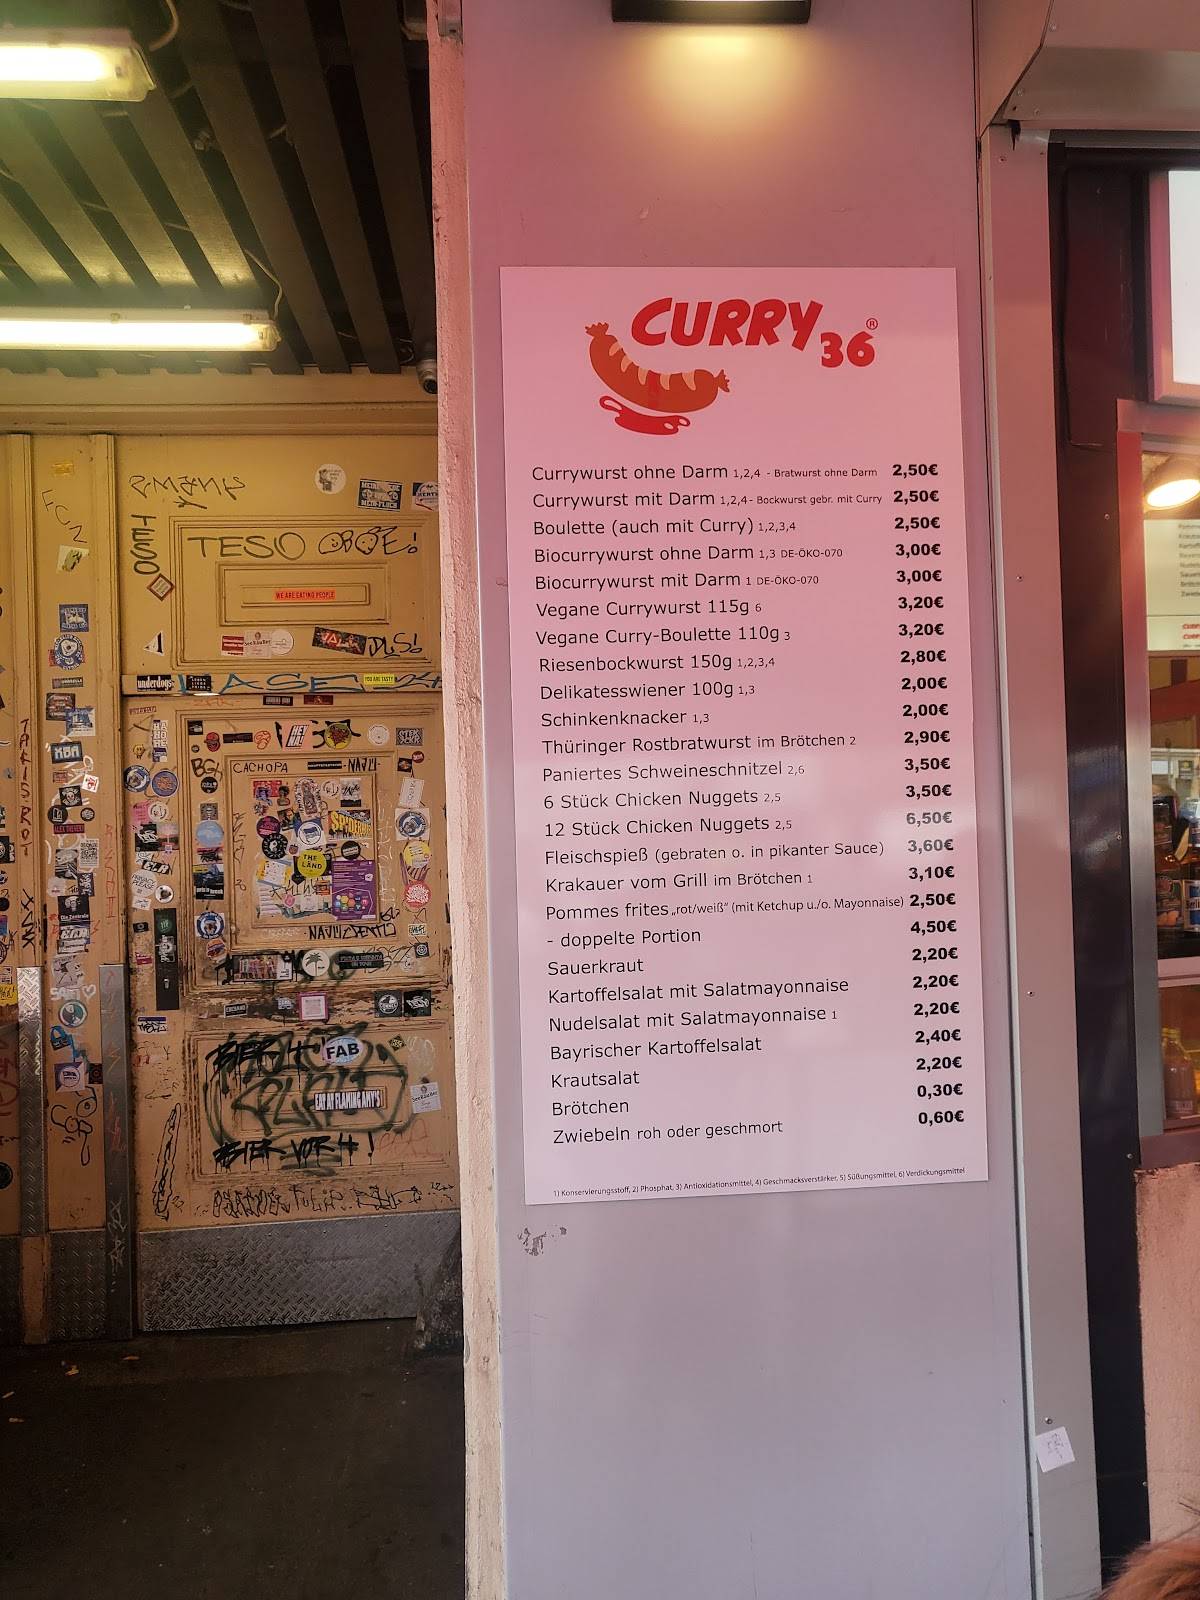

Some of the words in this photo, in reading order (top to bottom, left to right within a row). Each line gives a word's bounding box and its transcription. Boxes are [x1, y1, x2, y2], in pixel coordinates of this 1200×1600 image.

[631, 297, 823, 352] CURRY
[820, 330, 876, 368] 36
[532, 466, 628, 484] Currywurst
[633, 464, 676, 480] ohne
[682, 465, 728, 479] Darm
[733, 468, 761, 480] 1,2,4
[774, 468, 822, 478] Bratwurst
[824, 468, 848, 477] ohne
[851, 468, 878, 477] Darm
[892, 464, 938, 479] 2,50€
[533, 493, 629, 511] Currywurst
[635, 492, 663, 506] mit
[669, 492, 715, 506] Darm
[756, 495, 807, 505] Bockwurst
[809, 495, 833, 506] gebr.
[837, 494, 853, 504] mit
[855, 494, 883, 505] Curry
[894, 490, 940, 506] 2,50€
[533, 520, 605, 535] Boulette
[612, 519, 659, 538] (auch
[666, 519, 694, 533] mit
[700, 517, 754, 535] Curry)
[758, 521, 796, 534] 1,2,3,4
[894, 516, 940, 532] 2,50€
[187, 532, 306, 560] TESO
[534, 547, 654, 565] Biocurrywurst
[659, 546, 701, 561] ohne
[708, 545, 754, 560] Darm
[759, 549, 776, 561] 1,3
[780, 548, 843, 559] DE-ÖKO-070
[896, 544, 941, 559] 3,00€
[535, 574, 655, 592] Biocurrywurst
[661, 573, 689, 588] mit
[695, 573, 741, 587] Darm
[756, 575, 819, 586] DE-ÖKO-070
[896, 570, 942, 585] 3,00€
[275, 591, 284, 600] WE
[285, 591, 295, 599] ARE
[296, 591, 315, 599] EATING
[316, 591, 335, 599] PEOPLE
[535, 603, 600, 620] Vegane
[606, 600, 702, 618] Currywurst
[708, 599, 749, 616] 115g
[898, 596, 944, 612] 3,20€
[535, 631, 599, 648] Vegane
[605, 626, 731, 646] Curry-Boulette
[738, 625, 779, 643] 110g
[898, 623, 944, 639] 3,20€
[539, 655, 684, 672] Riesenbockwurst
[691, 654, 732, 671] 150g
[737, 657, 775, 669] 1,2,3,4
[900, 650, 946, 666] 2,80€
[137, 676, 172, 690] underdogs
[540, 683, 686, 700] Delikatesswiener
[692, 681, 733, 699] 100g
[738, 685, 755, 697] 1,3
[902, 677, 948, 692] 2,00€
[541, 709, 687, 727] Schinkenknacker
[693, 713, 710, 725] 1,3
[902, 704, 948, 719] 2,00€
[541, 739, 627, 756] Thüringer
[632, 735, 752, 752] Rostbratwurst
[757, 736, 775, 748] im
[780, 734, 845, 748] Brötchen
[904, 730, 950, 746] 2,90€
[233, 762, 288, 774] CACHOPA
[543, 767, 622, 782] Paniertes
[628, 760, 782, 780] Schweineschnitzel
[787, 765, 805, 776] 2,6
[904, 758, 950, 773] 3,50€
[544, 795, 554, 810] 6
[561, 793, 609, 809] Stück
[615, 791, 682, 807] Chicken
[689, 789, 758, 808] Nuggets
[763, 792, 781, 804] 2,5
[906, 784, 952, 800] 3,50€
[545, 822, 565, 837] 12
[572, 820, 621, 836] Stück
[626, 818, 693, 834] Chicken
[700, 816, 770, 835] Nuggets
[775, 819, 792, 831] 2,5
[906, 812, 952, 829] 6,50€
[545, 847, 648, 866] Fleischspieß
[655, 847, 726, 864] (gebraten
[731, 848, 745, 859] o.
[751, 848, 764, 858] in
[769, 844, 830, 860] pikanter
[834, 841, 884, 857] Sauce)
[906, 839, 954, 855] 3,60€
[546, 877, 624, 893] Krakauer
[630, 877, 666, 889] vom
[673, 872, 707, 888] Grill
[714, 876, 731, 886] im
[737, 871, 802, 886] Brötchen
[908, 866, 955, 882] 3,10€
[546, 906, 619, 920] Pommes
[624, 902, 669, 917] frites
[731, 902, 755, 914] (mit
[757, 899, 804, 913] Ketchup
[834, 896, 904, 911] Mayonnaise)
[910, 893, 956, 909] 2,50€
[560, 930, 635, 950] doppelte
[642, 928, 701, 944] Portion
[910, 920, 957, 936] 4,50€
[547, 958, 644, 976] Sauerkraut
[912, 947, 958, 964] 2,20€
[548, 985, 664, 1004] Kartoffelsalat
[670, 983, 698, 999] mit
[703, 980, 849, 998] Salatmayonnaise
[912, 974, 959, 990] 2,20€
[549, 1014, 641, 1032] Nudelsalat
[647, 1012, 675, 1028] mit
[681, 1006, 827, 1027] Salatmayonnaise
[914, 1002, 960, 1018] 2,20€
[326, 1043, 360, 1060] FAB
[550, 1042, 642, 1063] Bayrischer
[648, 1036, 762, 1056] Kartoffelsalat
[915, 1029, 961, 1046] 2,40€
[551, 1070, 640, 1088] Krautsalat
[916, 1056, 962, 1072] 2,20€
[552, 1099, 629, 1116] Brötchen
[917, 1083, 963, 1100] 0,30€
[553, 1126, 630, 1144] Zwiebeln
[637, 1126, 661, 1140] roh
[667, 1124, 701, 1138] oder
[705, 1120, 783, 1139] geschmort
[918, 1110, 964, 1127] 0,60€
[905, 1167, 966, 1177] Verdickungsmittel
